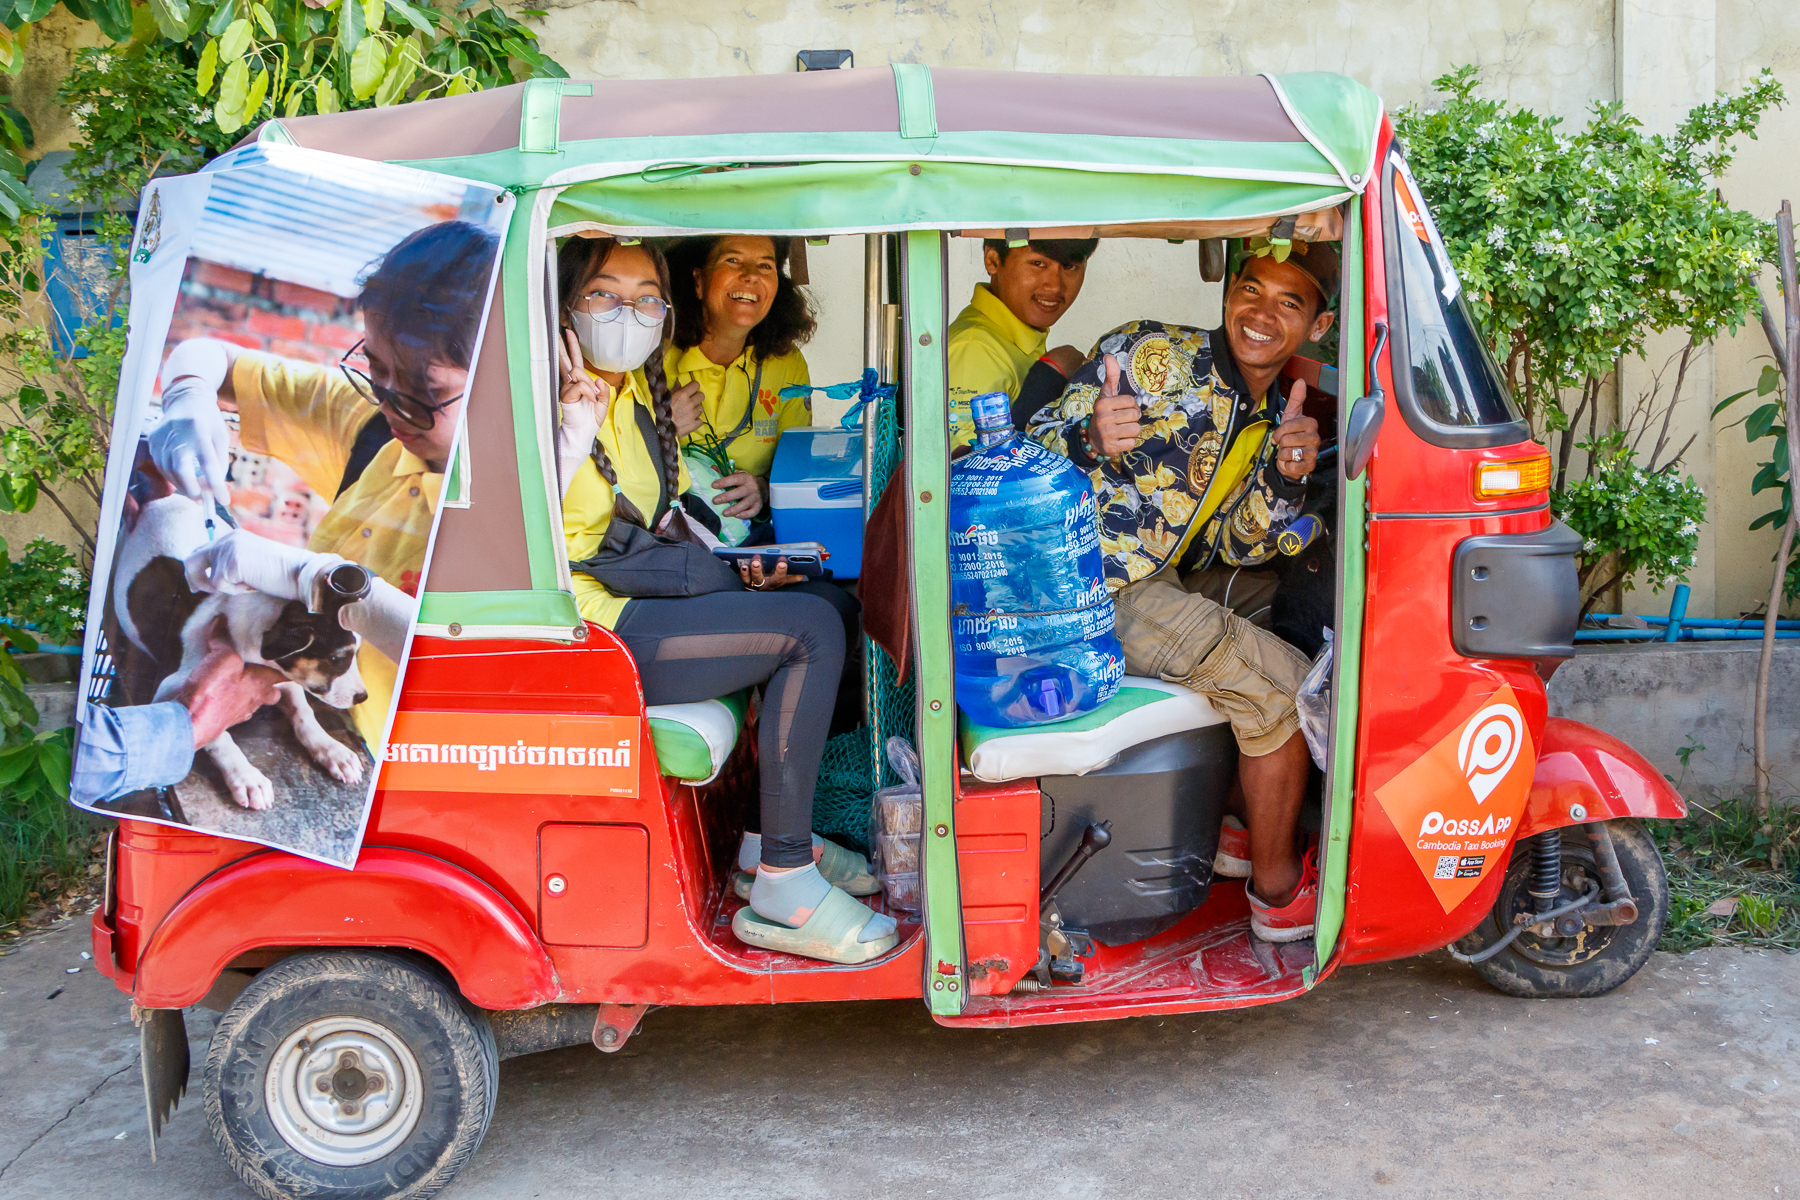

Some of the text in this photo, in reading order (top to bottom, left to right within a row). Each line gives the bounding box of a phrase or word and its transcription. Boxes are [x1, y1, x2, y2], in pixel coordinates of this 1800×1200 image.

[982, 552, 1003, 560] 2015
[1002, 636, 1023, 647] 2015
[1418, 811, 1512, 838] PassApp
[1416, 838, 1507, 851] Cambodia Taxi Booking
